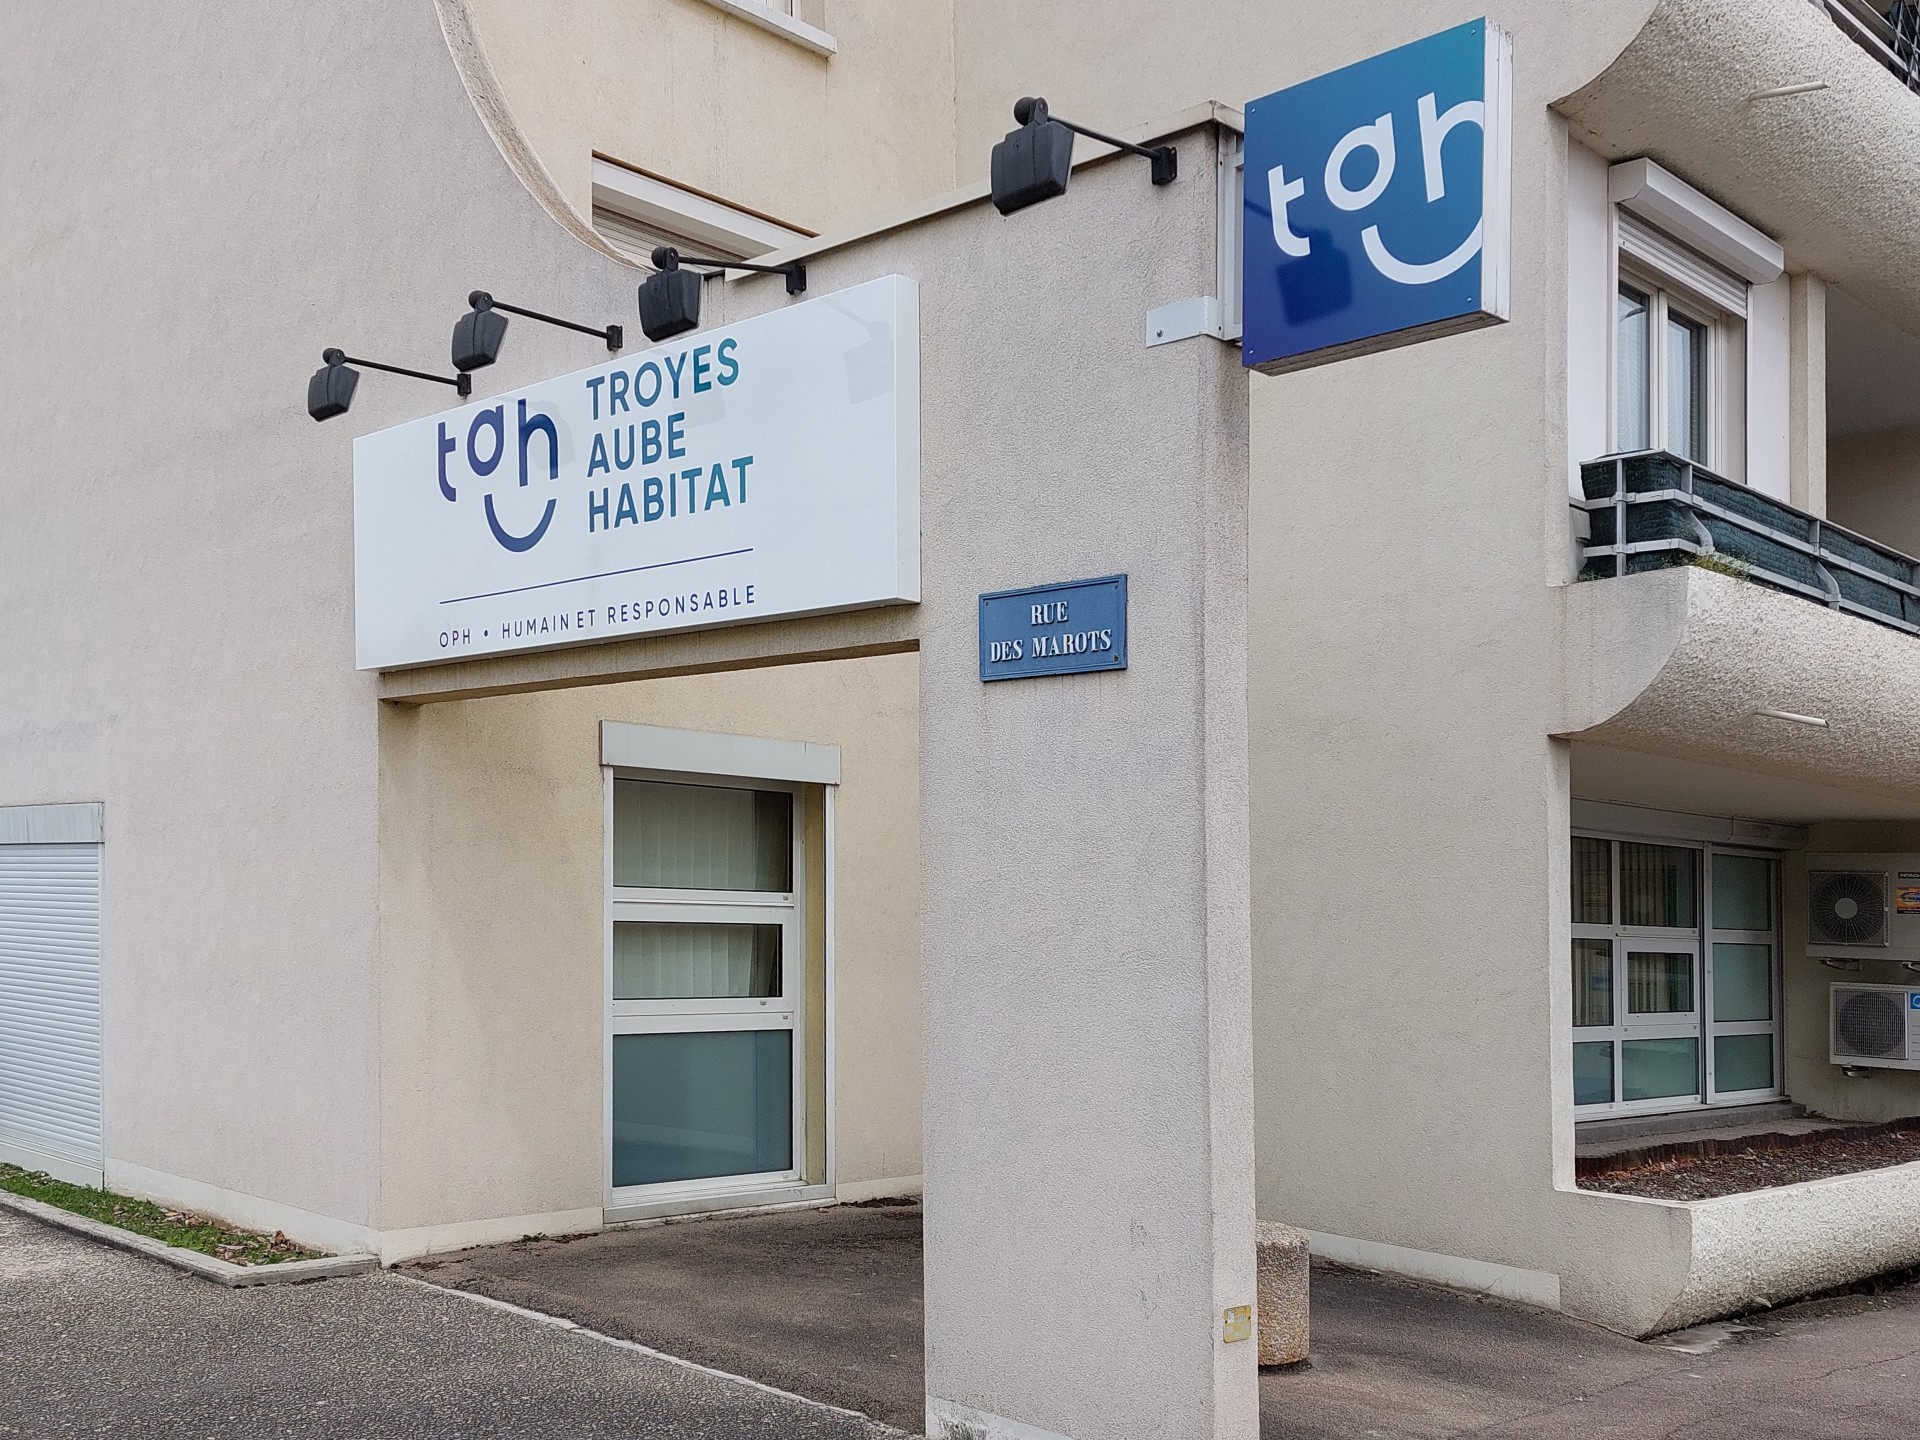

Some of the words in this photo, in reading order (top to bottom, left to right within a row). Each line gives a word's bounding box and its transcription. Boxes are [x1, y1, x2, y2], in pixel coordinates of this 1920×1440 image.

[586, 338, 739, 420] TROYES
[438, 398, 559, 502] tah
[587, 412, 686, 478] AUBE
[589, 456, 754, 533] HABITAT
[439, 628, 471, 648] OPH
[502, 613, 570, 639] HUMAIN
[576, 609, 597, 628] ET
[607, 584, 755, 624] RESPONSABLE
[990, 640, 1023, 662] DES
[1031, 629, 1112, 658] MAROTS
[1030, 601, 1069, 625] RUE
